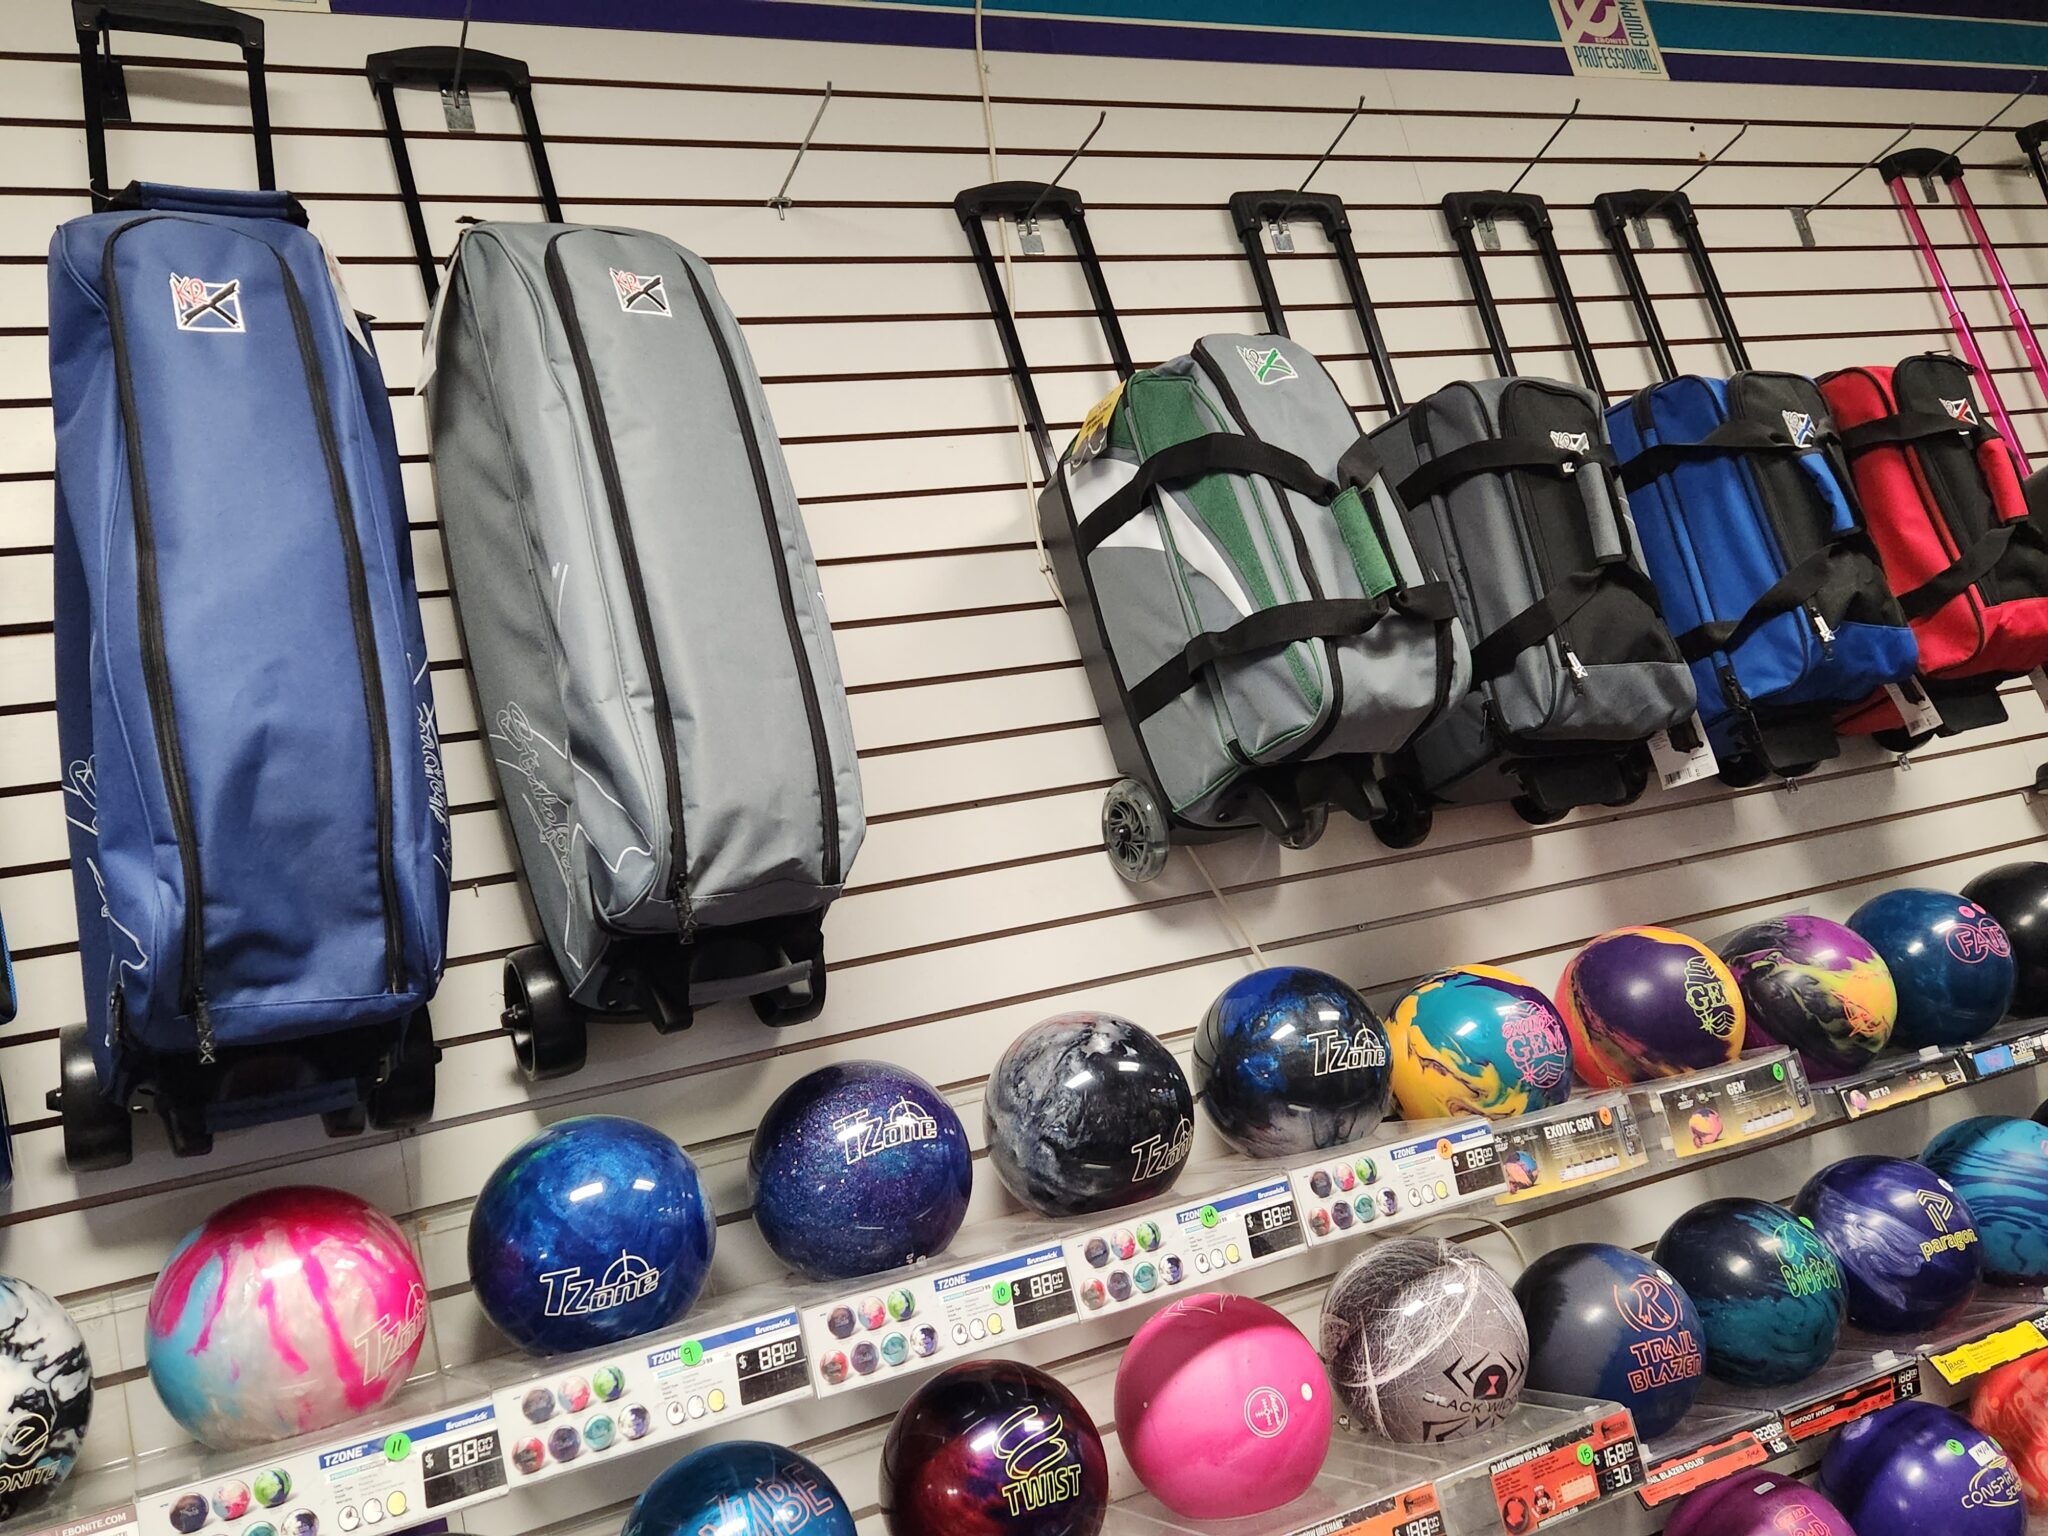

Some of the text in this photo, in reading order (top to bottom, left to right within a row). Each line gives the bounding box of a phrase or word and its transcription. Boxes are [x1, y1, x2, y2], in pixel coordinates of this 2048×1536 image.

[1573, 45, 1658, 71] PROFESSIONAL
[1726, 1080, 1746, 1096] GEM
[1543, 1117, 1594, 1140] EXOTIC GEM
[1180, 1210, 1201, 1223] TZON
[1246, 1215, 1253, 1228] $
[1920, 1228, 1978, 1261] paragon
[937, 1273, 967, 1290] TZONE
[1012, 1283, 1021, 1296] $
[755, 1318, 791, 1335] Brunswick
[684, 1347, 694, 1361] 9
[1630, 1331, 1697, 1366] TRAIL
[652, 1349, 680, 1366] TZON
[738, 1354, 747, 1370] $
[1901, 1382, 1914, 1398] 59
[445, 1411, 488, 1430] Brunswick
[1790, 1413, 1815, 1428] BIGFOOT
[1815, 1404, 1835, 1418] HYBRID
[1769, 1437, 1788, 1454] 66
[324, 1448, 363, 1467] TZONE
[424, 1452, 434, 1469] $
[1580, 1448, 1591, 1461] 15
[1594, 1453, 1600, 1466] $
[1660, 1464, 1685, 1481] BLAZER
[1684, 1457, 1704, 1471] SOLID
[1002, 1464, 1081, 1516] TWIST
